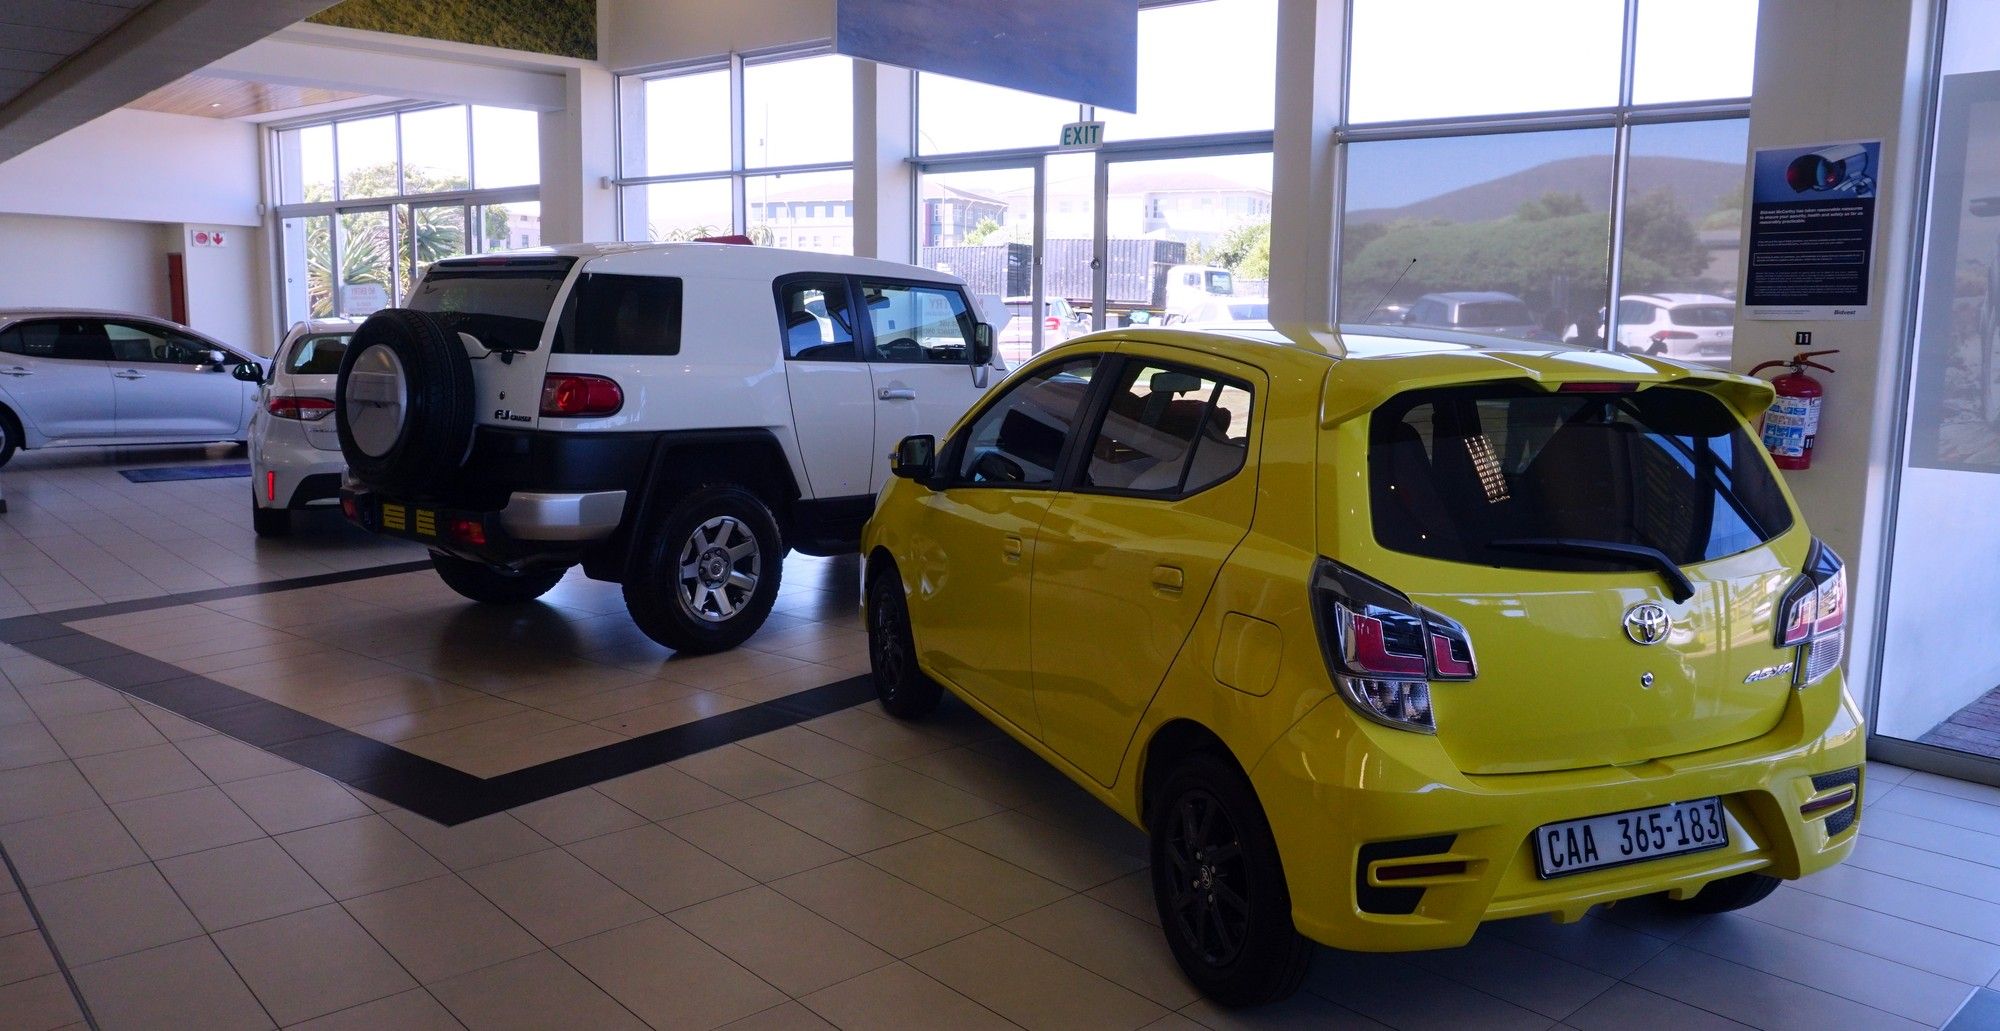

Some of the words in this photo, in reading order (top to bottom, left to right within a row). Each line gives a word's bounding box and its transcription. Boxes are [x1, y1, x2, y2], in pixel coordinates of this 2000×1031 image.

[1063, 125, 1100, 146] EXIT
[1798, 333, 1809, 344] 11
[494, 409, 510, 420] FJ
[1547, 824, 1599, 868] CAA
[1617, 803, 1720, 856] 365-183
